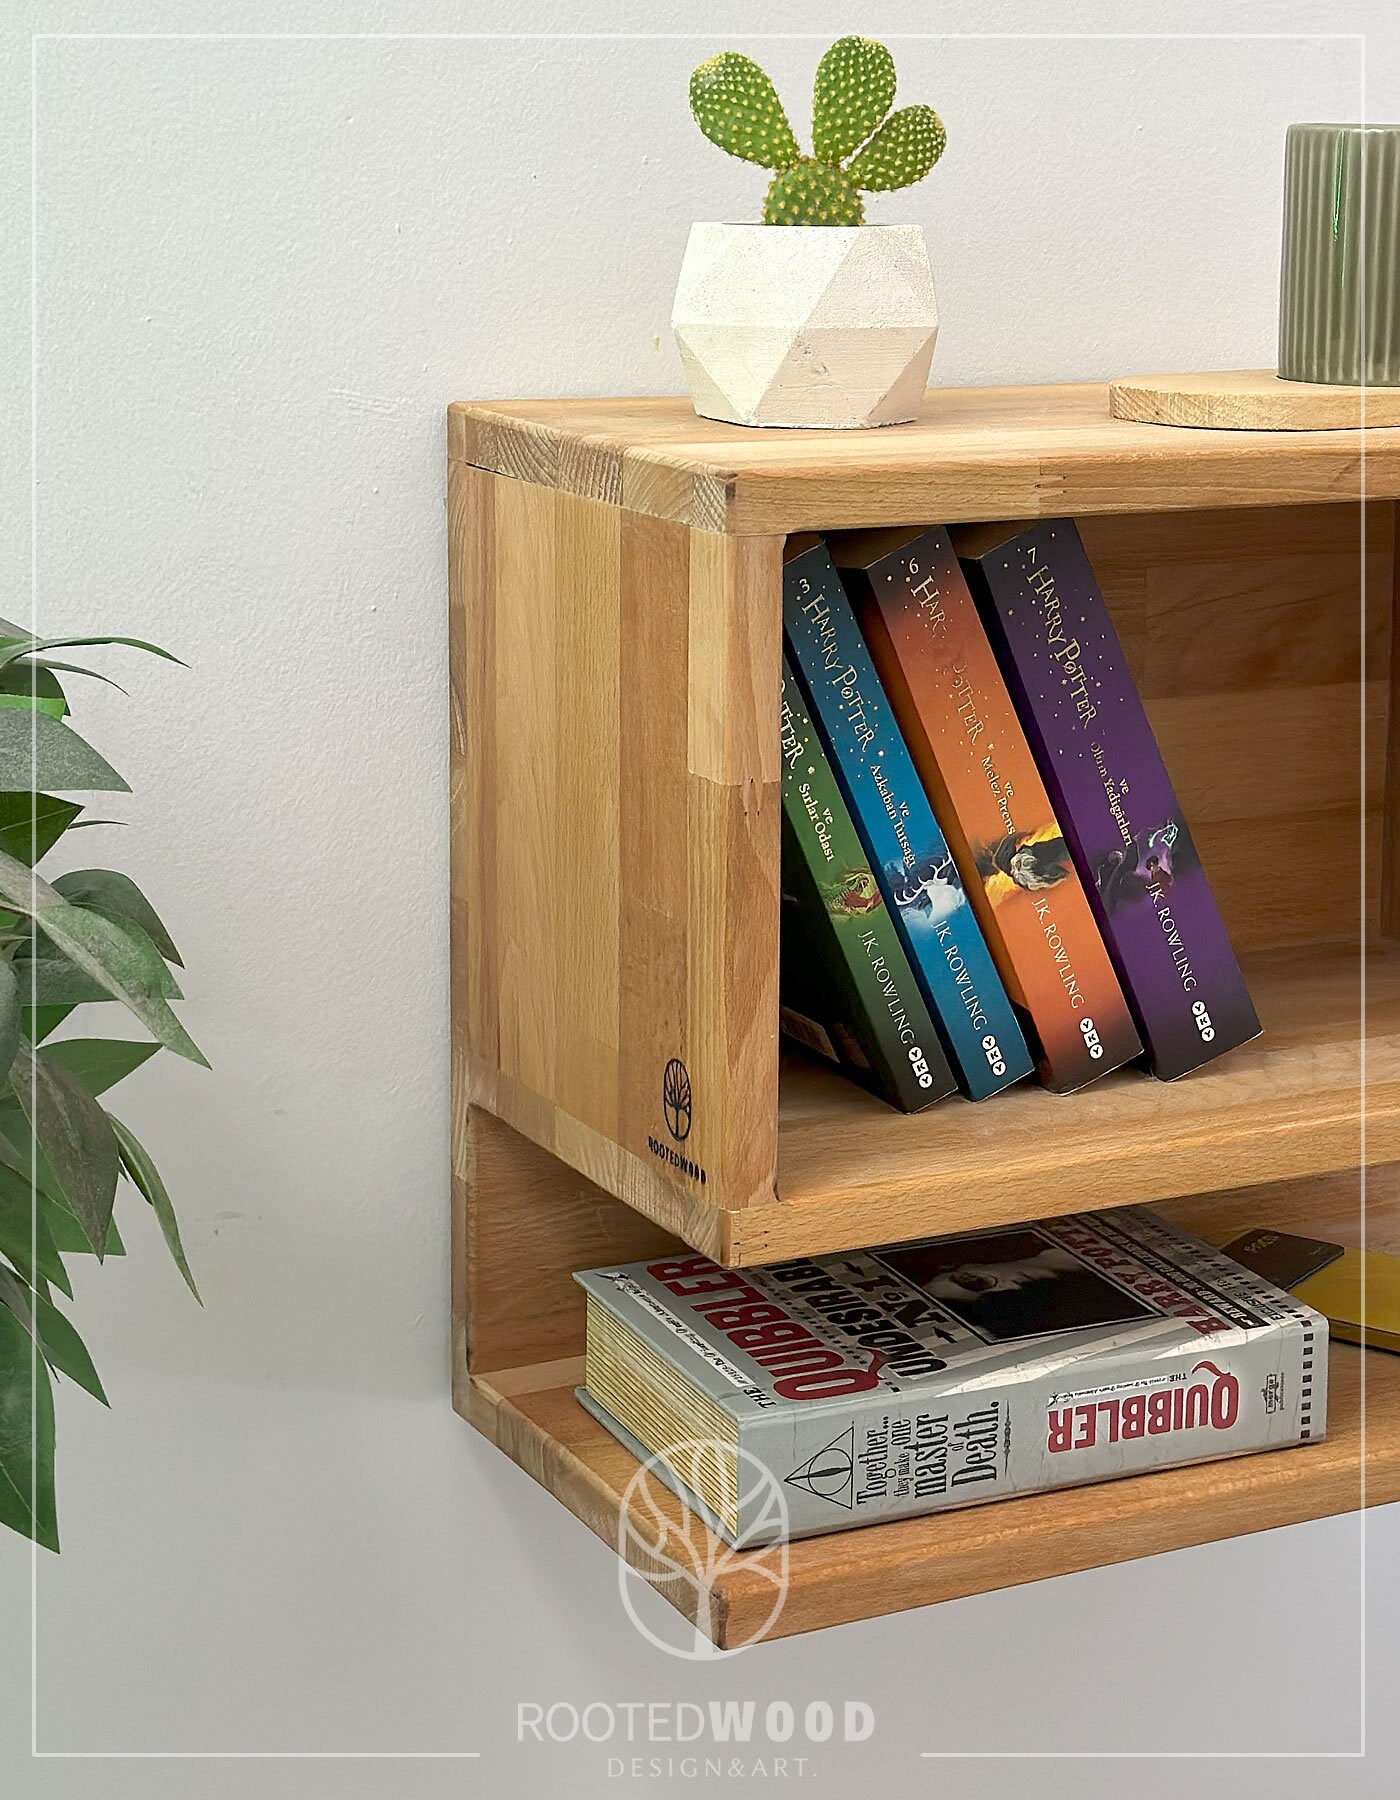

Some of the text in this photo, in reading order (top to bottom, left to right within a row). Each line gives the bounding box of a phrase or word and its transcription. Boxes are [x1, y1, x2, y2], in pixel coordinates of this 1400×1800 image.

[798, 578, 811, 594] 3
[908, 557, 919, 575] 6
[1026, 546, 1037, 564] 7
[801, 593, 876, 753] HARRY POTTER
[1026, 564, 1097, 730] HARRY POTTER
[798, 782, 836, 863] Sırlar Odası
[822, 807, 834, 825] ve
[870, 764, 898, 821] Azkaban
[898, 801, 911, 817] ve
[981, 755, 1016, 835] Melez Prens
[1003, 781, 1015, 798] ve
[1119, 778, 1130, 795] ve
[933, 920, 988, 1031] J.K. ROWLING
[1031, 898, 1085, 1010] J.K. ROWLING
[1145, 881, 1199, 993] J.K. ROWLING
[857, 930, 916, 1045] J.K. ROWLING
[647, 1135, 707, 1185] ROOTEDWOOD
[647, 1256, 887, 1400] QUIBBLER
[1113, 1271, 1233, 1335] HARRY
[743, 1386, 777, 1409] THE
[1047, 1360, 1240, 1454] QUIBBLER
[1169, 1372, 1188, 1383] THE
[856, 1416, 897, 1505] Together...
[890, 1418, 915, 1498] they make one
[903, 1413, 949, 1499] master
[947, 1441, 965, 1452] of
[951, 1401, 1000, 1488] Death.
